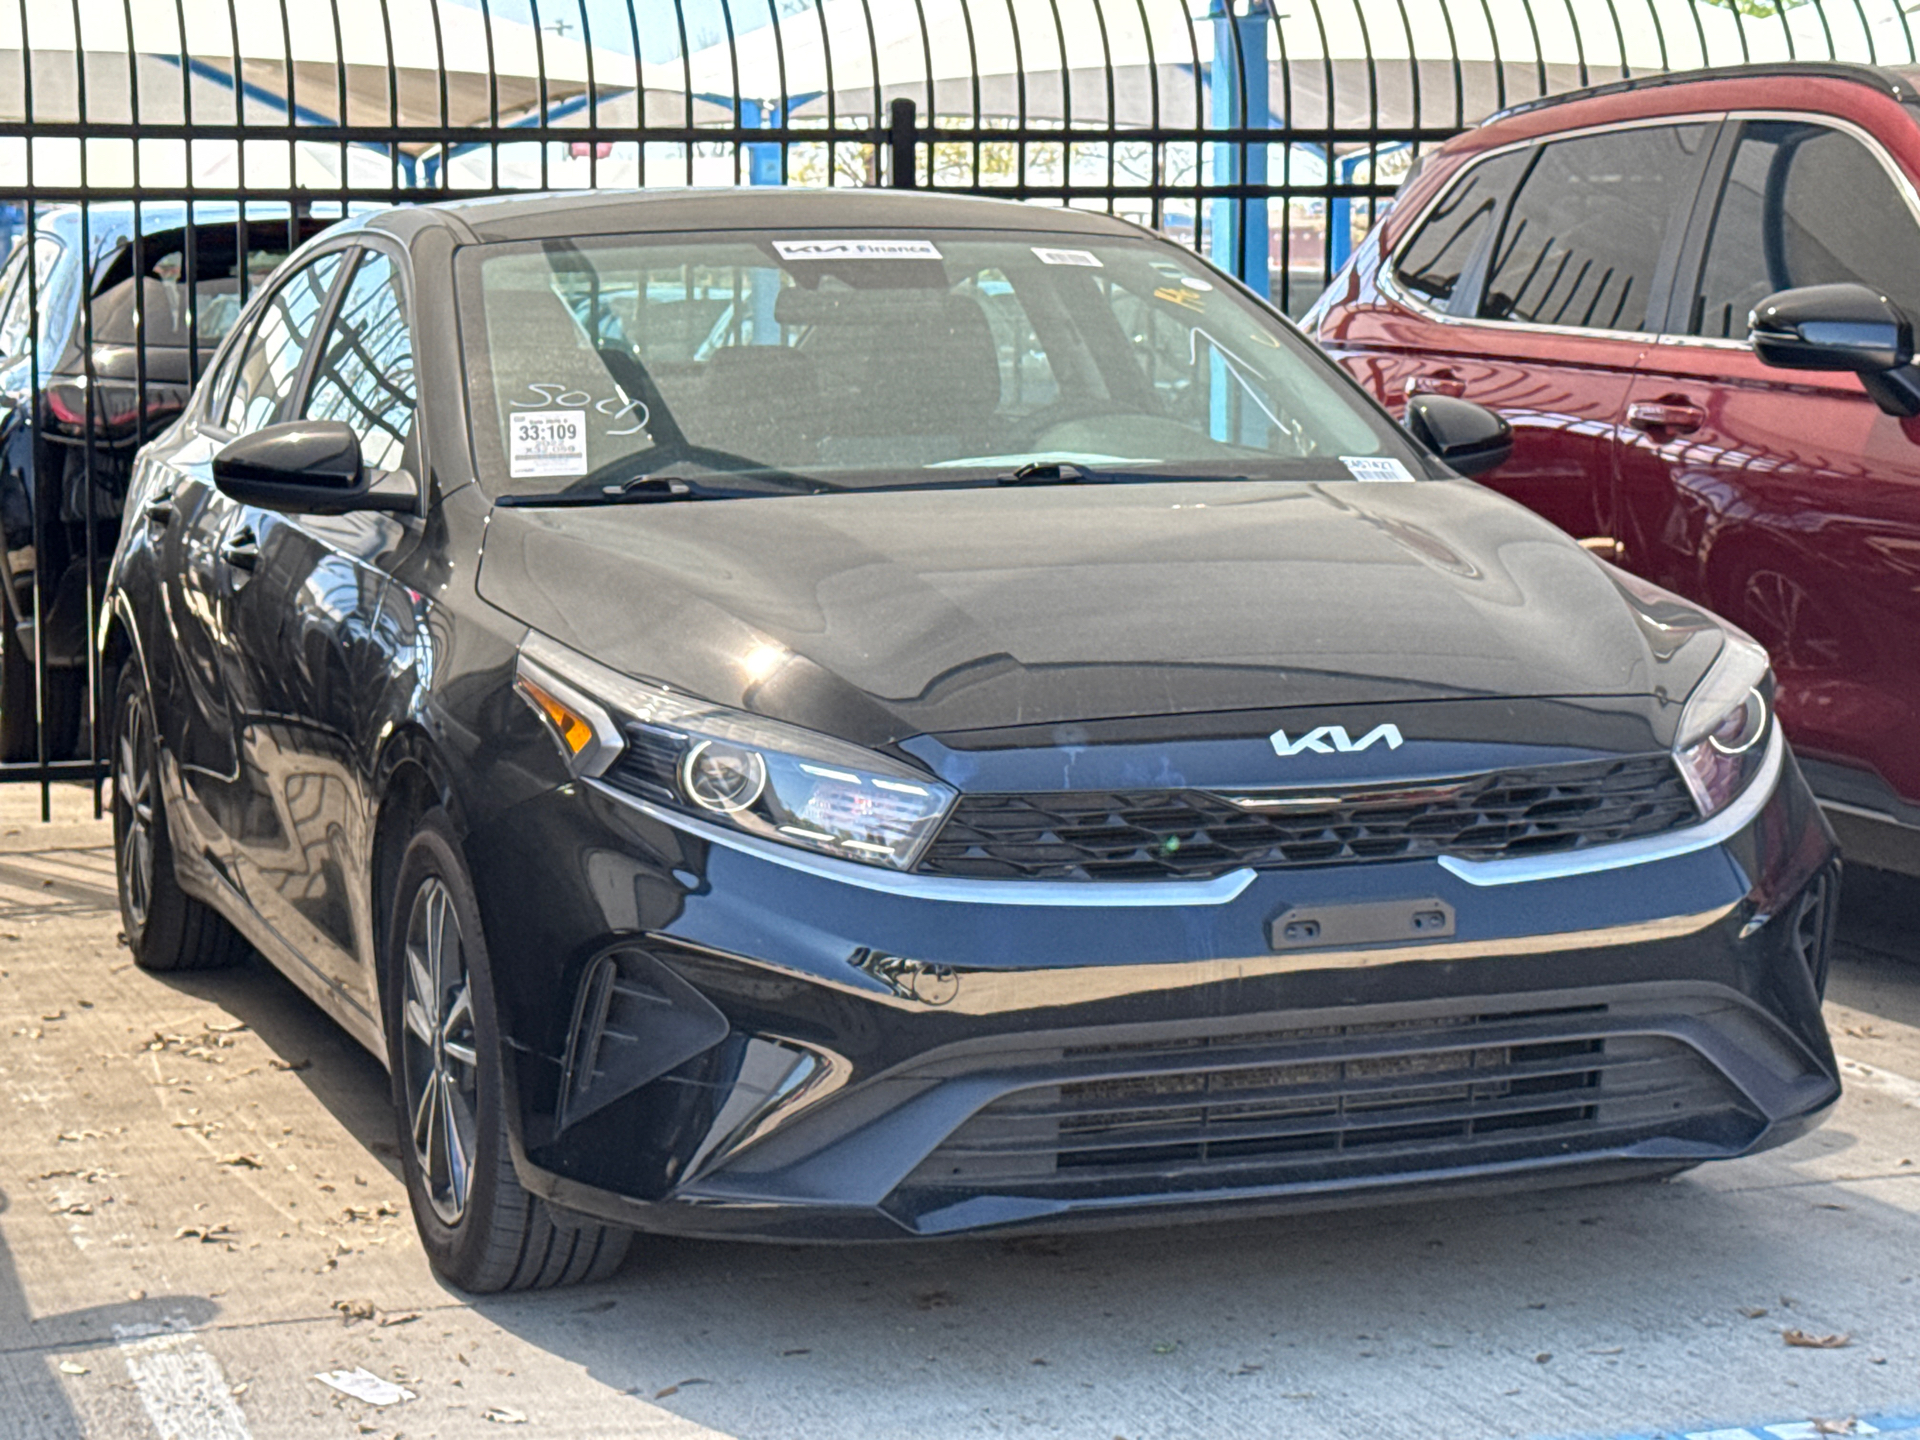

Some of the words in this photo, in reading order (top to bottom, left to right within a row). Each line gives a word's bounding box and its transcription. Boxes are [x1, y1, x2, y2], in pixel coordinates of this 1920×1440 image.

[782, 244, 850, 255] KIA
[855, 244, 932, 255] Finance
[518, 423, 577, 442] 33:109
[1269, 723, 1404, 757] KIA
